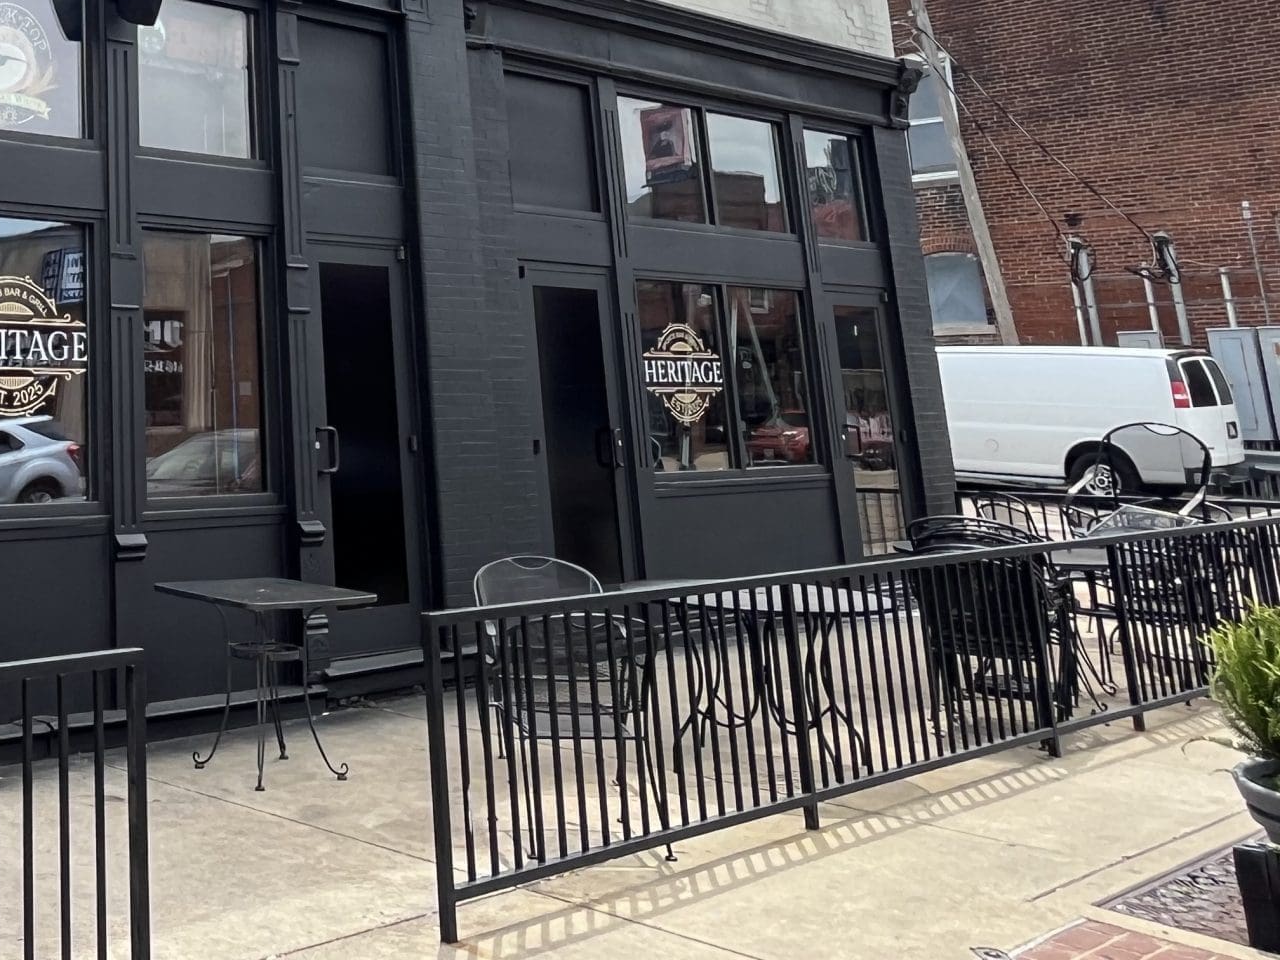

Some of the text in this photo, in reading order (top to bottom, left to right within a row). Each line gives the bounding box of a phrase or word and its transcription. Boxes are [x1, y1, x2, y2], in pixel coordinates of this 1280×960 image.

[3, 288, 20, 297] BAR
[21, 292, 28, 300] &
[28, 294, 49, 318] GRILL
[643, 360, 723, 383] HERITAGE
[13, 380, 44, 407] 2025
